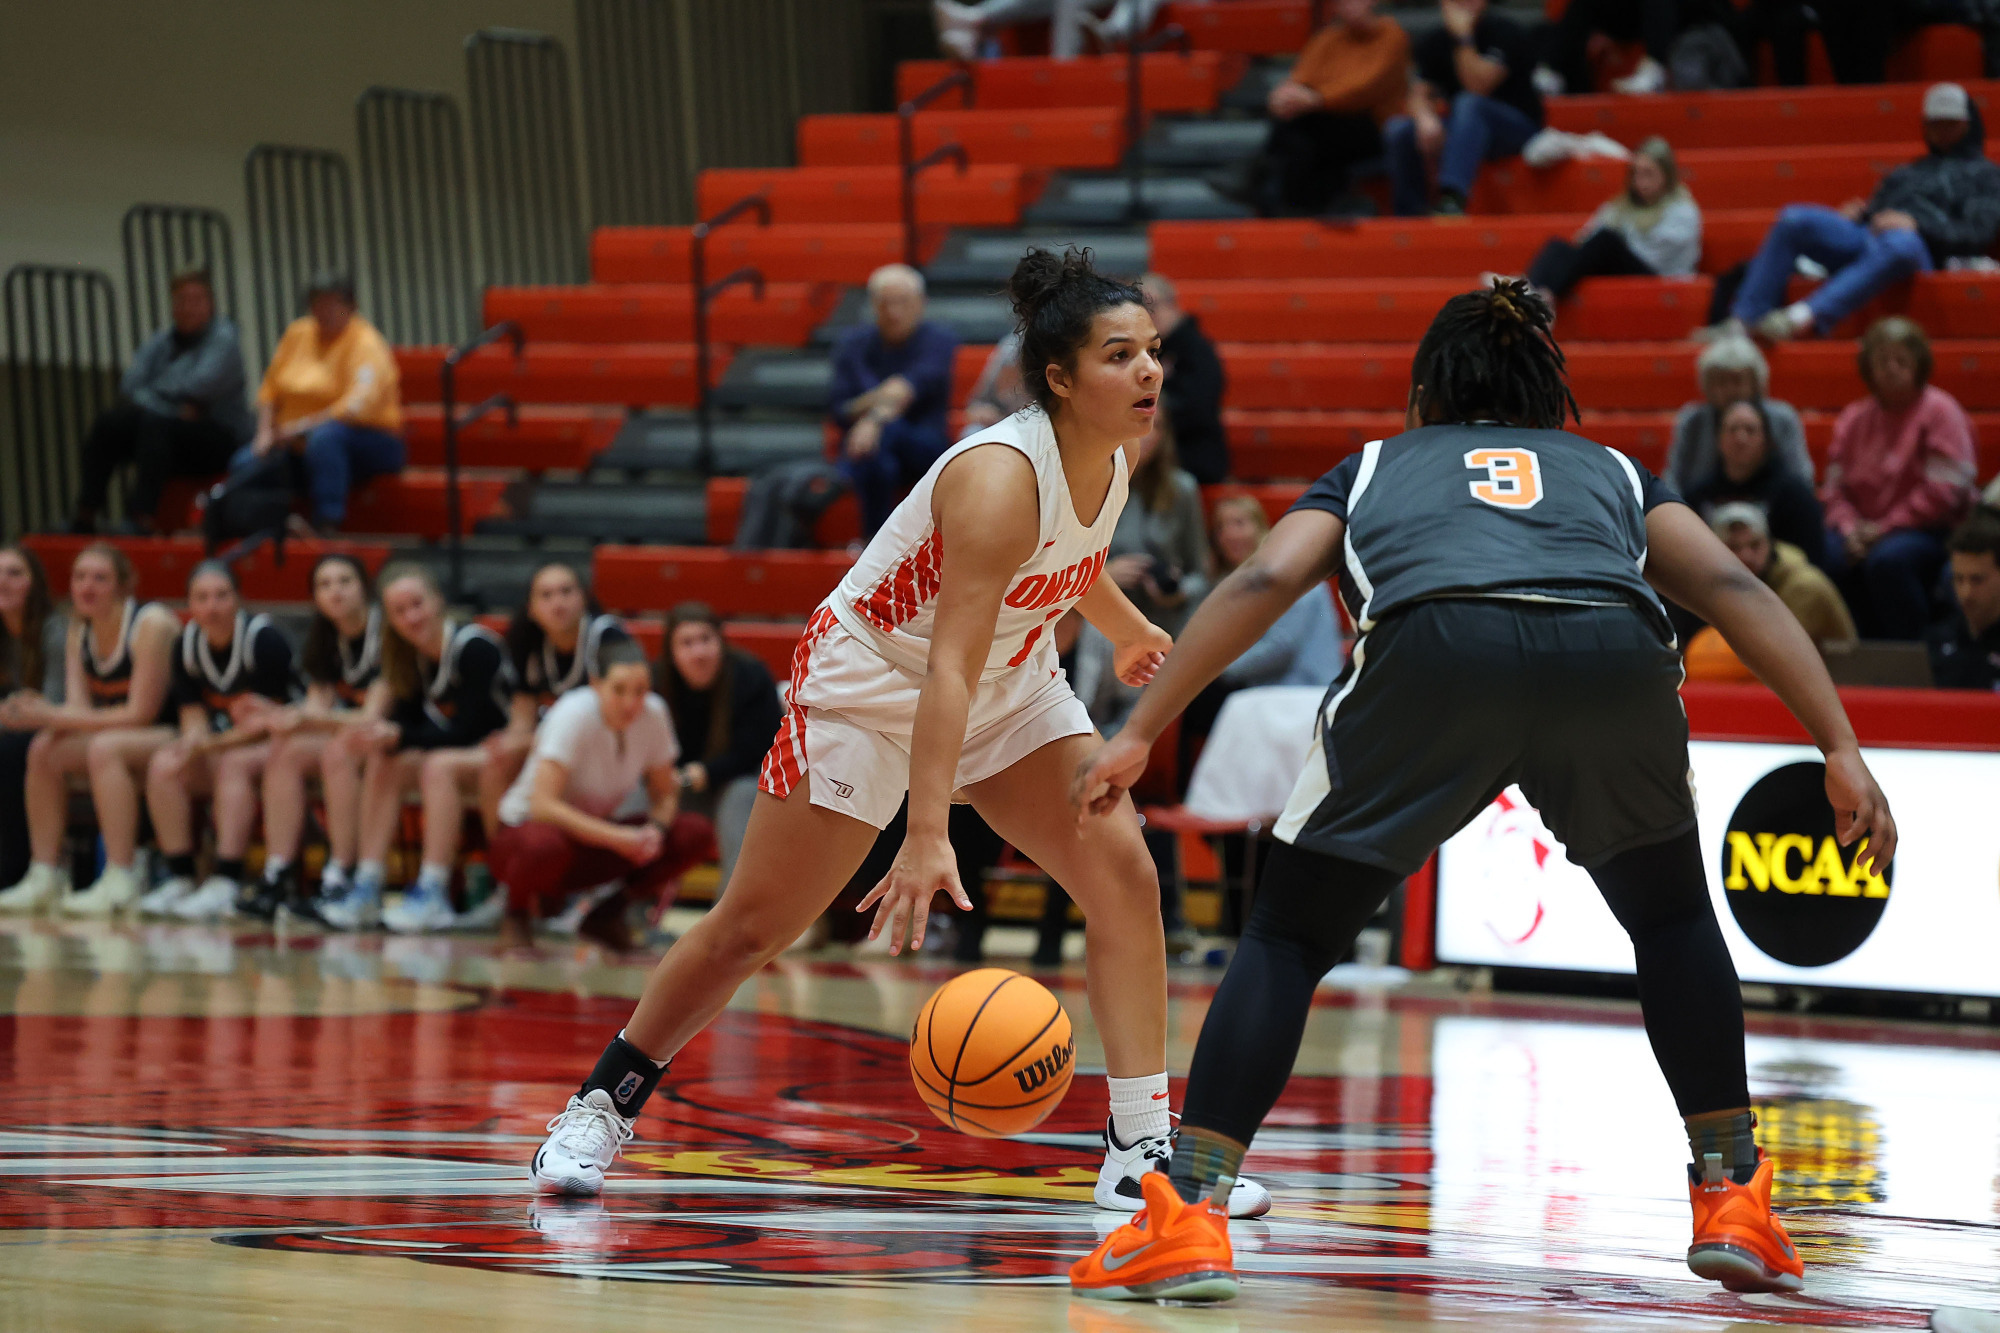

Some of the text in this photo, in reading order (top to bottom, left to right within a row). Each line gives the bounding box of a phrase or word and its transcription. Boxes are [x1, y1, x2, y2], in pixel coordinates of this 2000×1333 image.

[1463, 447, 1544, 510] 3
[1004, 544, 1111, 611] ONEON
[1724, 830, 1891, 899] NCAA
